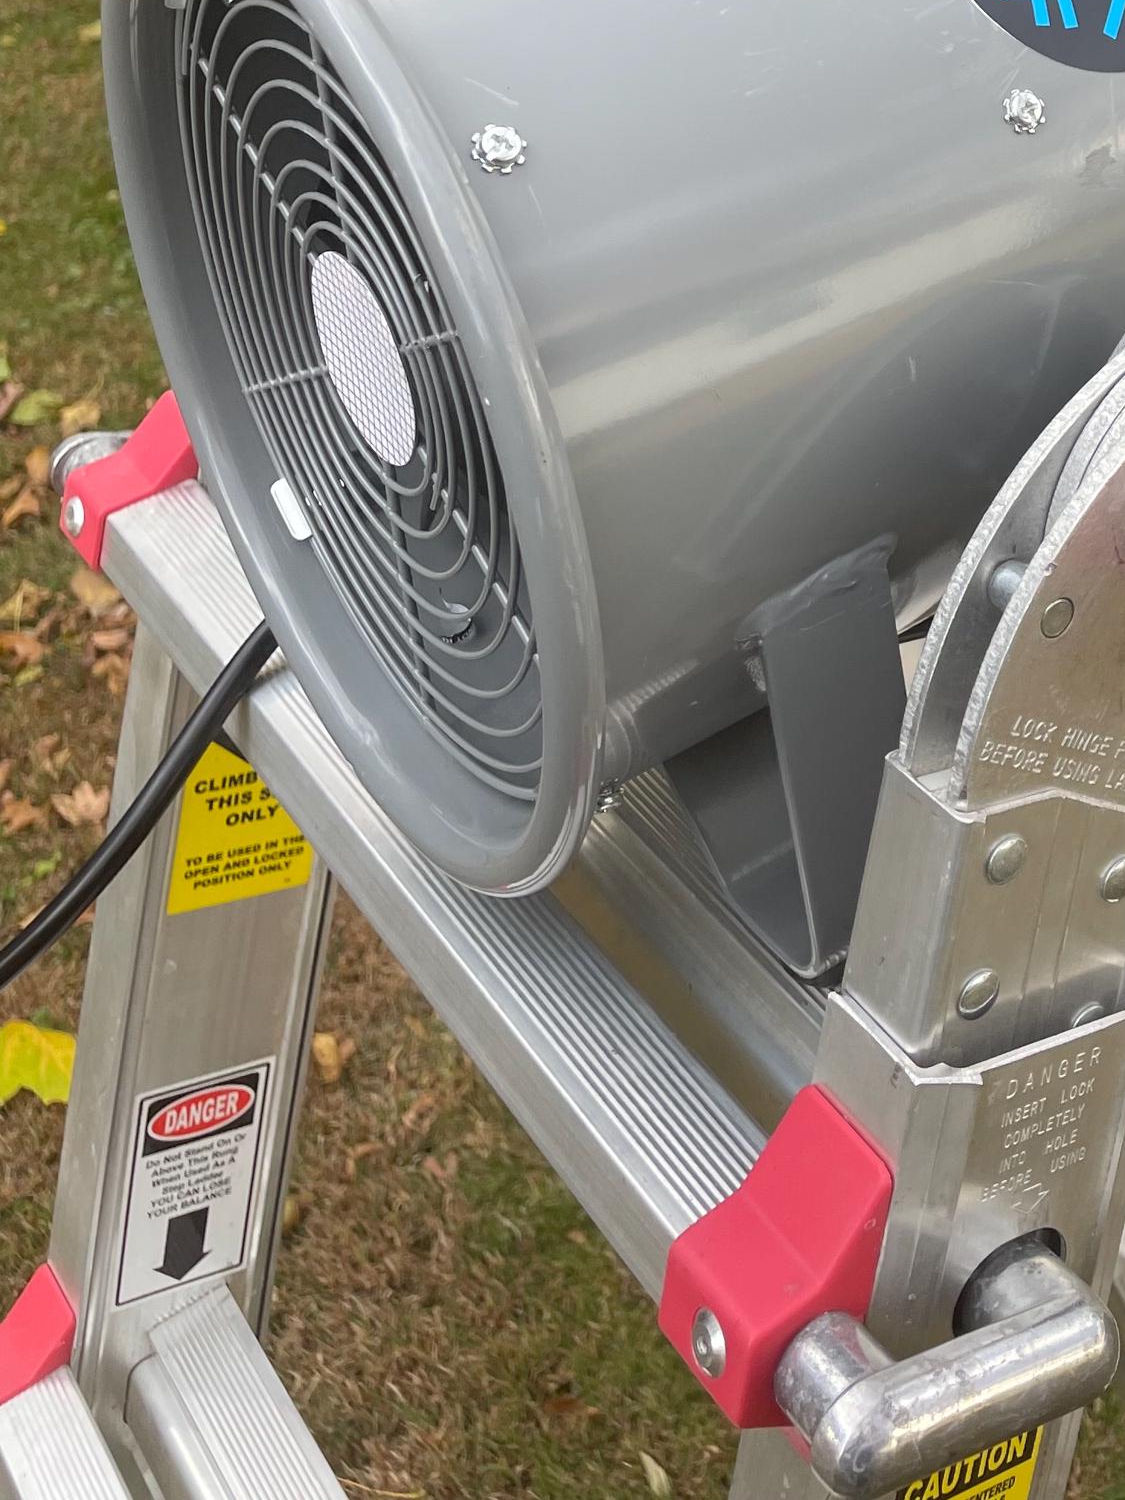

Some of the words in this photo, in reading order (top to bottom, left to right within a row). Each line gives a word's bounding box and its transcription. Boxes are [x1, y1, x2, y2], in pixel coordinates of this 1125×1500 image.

[1011, 716, 1058, 742] LOCK
[1061, 727, 1113, 756] HINGE
[979, 741, 1048, 773] BEFORE
[1052, 756, 1101, 785] USING
[195, 771, 258, 794] CLIMB
[205, 791, 253, 811] THIS
[226, 803, 280, 827] ONLY
[184, 865, 220, 880] OPEN
[223, 858, 250, 872] AND
[254, 846, 304, 865] LOCKED
[186, 856, 203, 867] TO
[206, 852, 223, 863] BE
[227, 844, 261, 858] USED
[265, 839, 279, 850] IN
[193, 868, 255, 890] POSITION
[258, 861, 292, 875] ONLY
[1006, 1046, 1101, 1099] DANGER
[164, 1091, 239, 1135] DANGER
[1001, 1097, 1047, 1128] INSERT
[1060, 1077, 1096, 1105] LOCK
[1004, 1103, 1085, 1149] COMPLETELY
[151, 1162, 184, 1178] Above
[188, 1155, 208, 1166] This
[163, 1152, 182, 1164] Not
[216, 1137, 232, 1148] On
[999, 1150, 1026, 1174] INTO
[1044, 1128, 1079, 1155] HOLE
[152, 1173, 181, 1187] When
[184, 1164, 210, 1178] Used
[212, 1160, 225, 1170] As
[981, 1168, 1033, 1203] BEFORE
[1050, 1146, 1087, 1173] USING
[147, 1204, 178, 1219] YOUR
[181, 1186, 232, 1209] BALANCE
[150, 1195, 174, 1208] YOU
[176, 1187, 200, 1200] CAN
[202, 1176, 231, 1192] LOSE
[904, 1431, 1028, 1500] CAUTION
